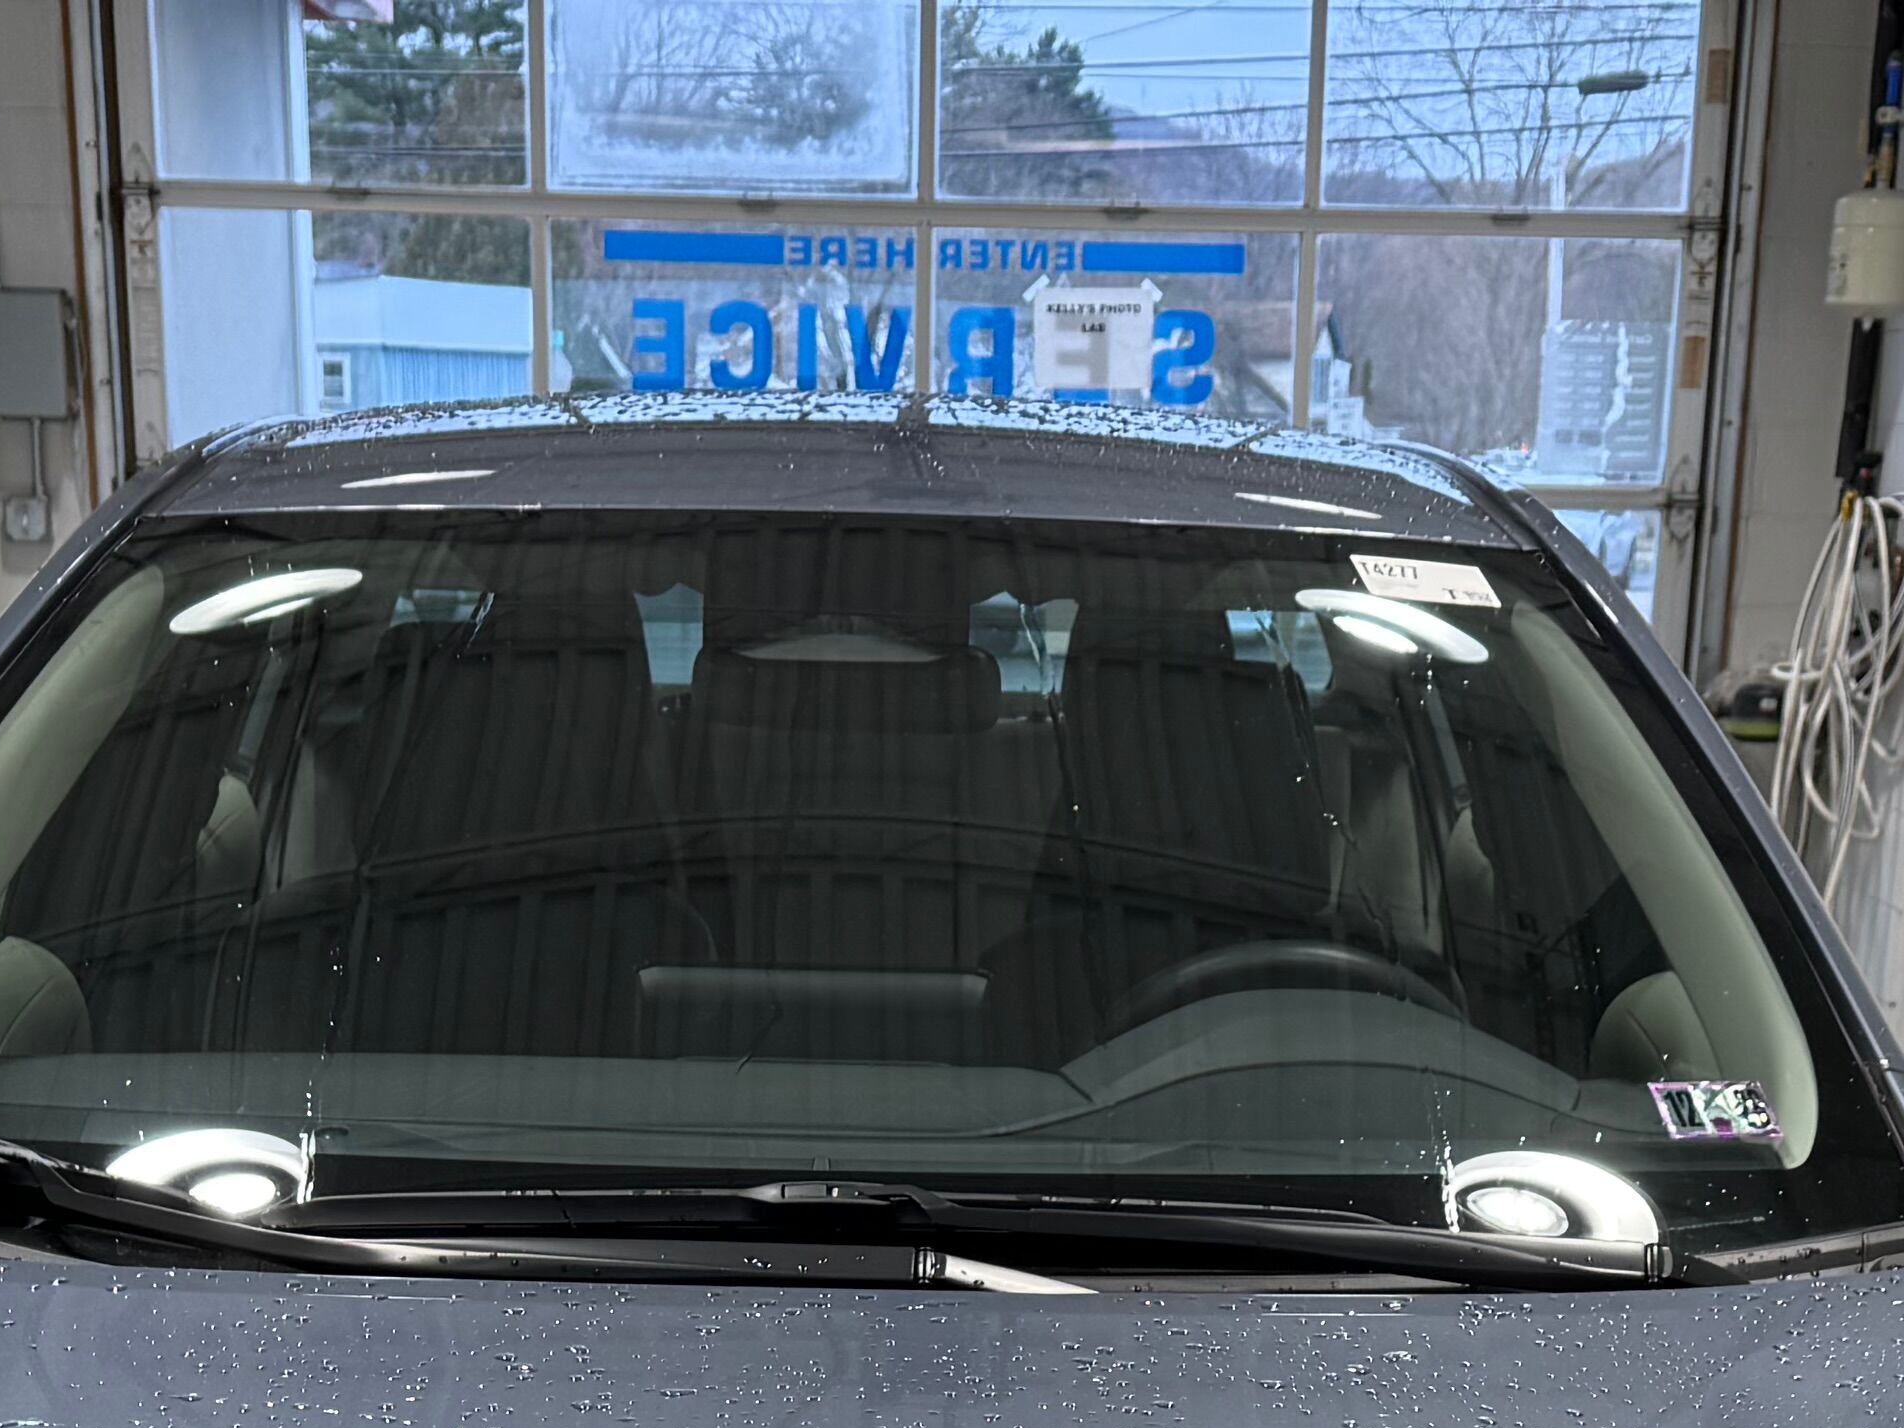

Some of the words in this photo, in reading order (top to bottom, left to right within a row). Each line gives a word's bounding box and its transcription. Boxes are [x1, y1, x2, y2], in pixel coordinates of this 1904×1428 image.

[1099, 303, 1142, 314] PHOTO
[1081, 322, 1107, 333] LAB
[1663, 1089, 1705, 1128] 12
